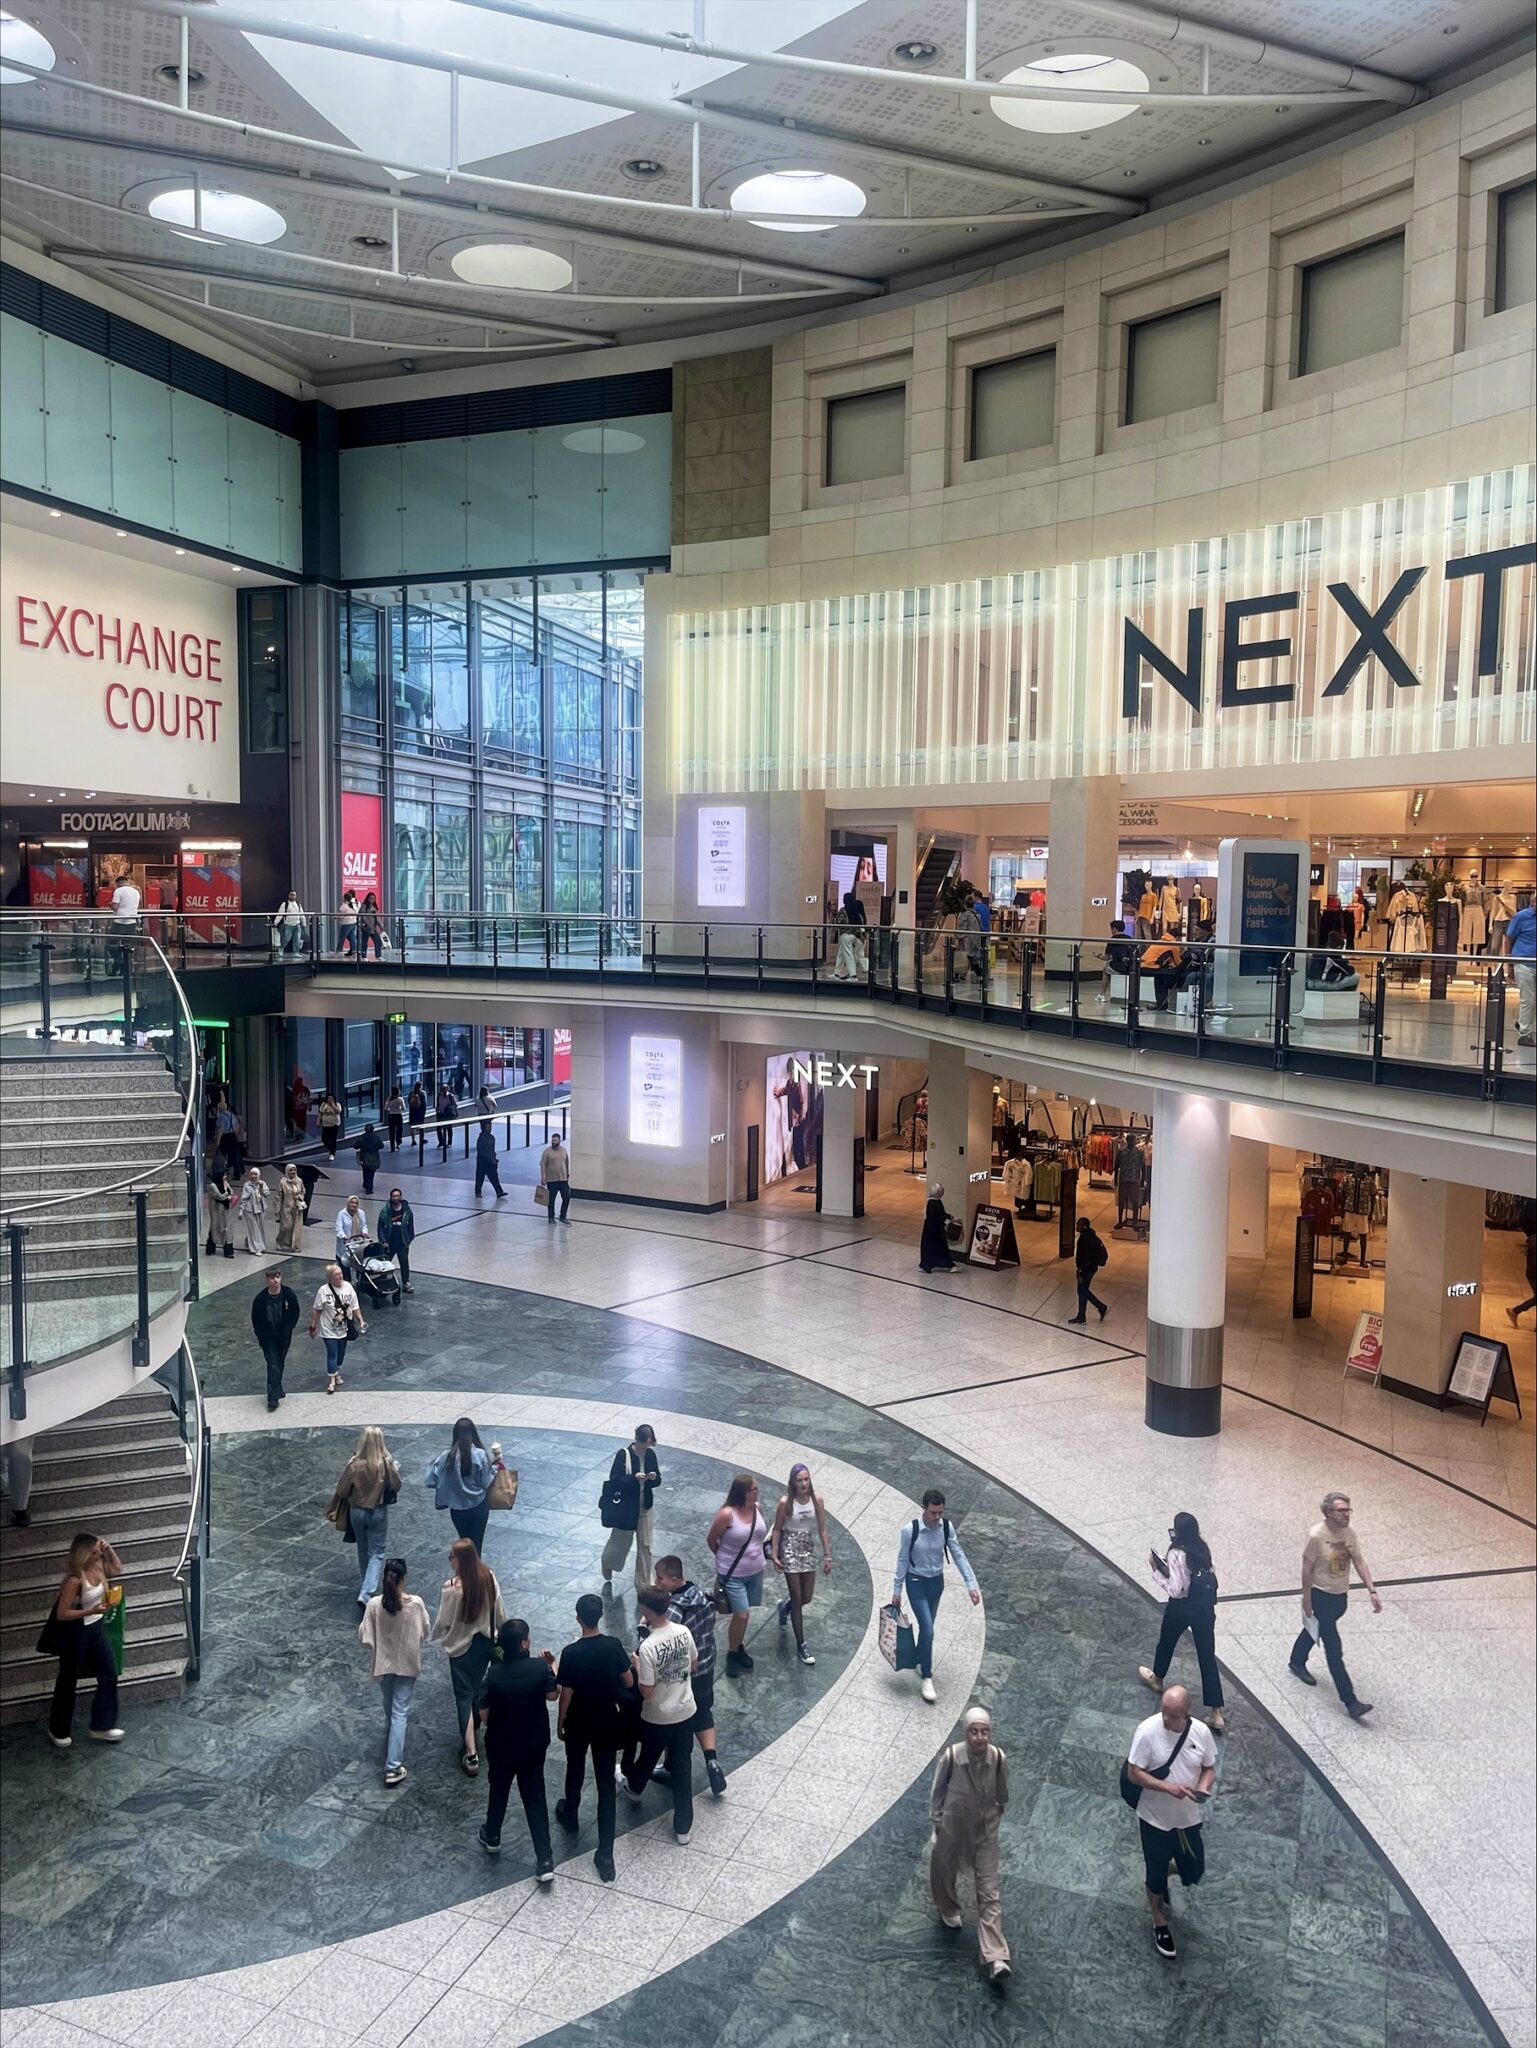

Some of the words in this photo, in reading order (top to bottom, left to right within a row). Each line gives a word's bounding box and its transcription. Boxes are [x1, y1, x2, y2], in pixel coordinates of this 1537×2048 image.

[1122, 542, 1537, 719] NEXT
[17, 595, 223, 683] EXCHANGE
[105, 683, 223, 743] COURT
[343, 851, 377, 877] SALE
[1246, 875, 1277, 889] Happy
[33, 892, 55, 905] SALE
[60, 893, 83, 905] SALE
[185, 895, 210, 908] SALE
[1246, 890, 1273, 900] bums
[215, 896, 240, 908] SALE
[1245, 904, 1291, 916] delivered
[1245, 917, 1269, 929] fast.
[792, 1059, 880, 1091] NEXT
[1447, 1283, 1478, 1298] NEXT
[1367, 1316, 1383, 1328] BIG
